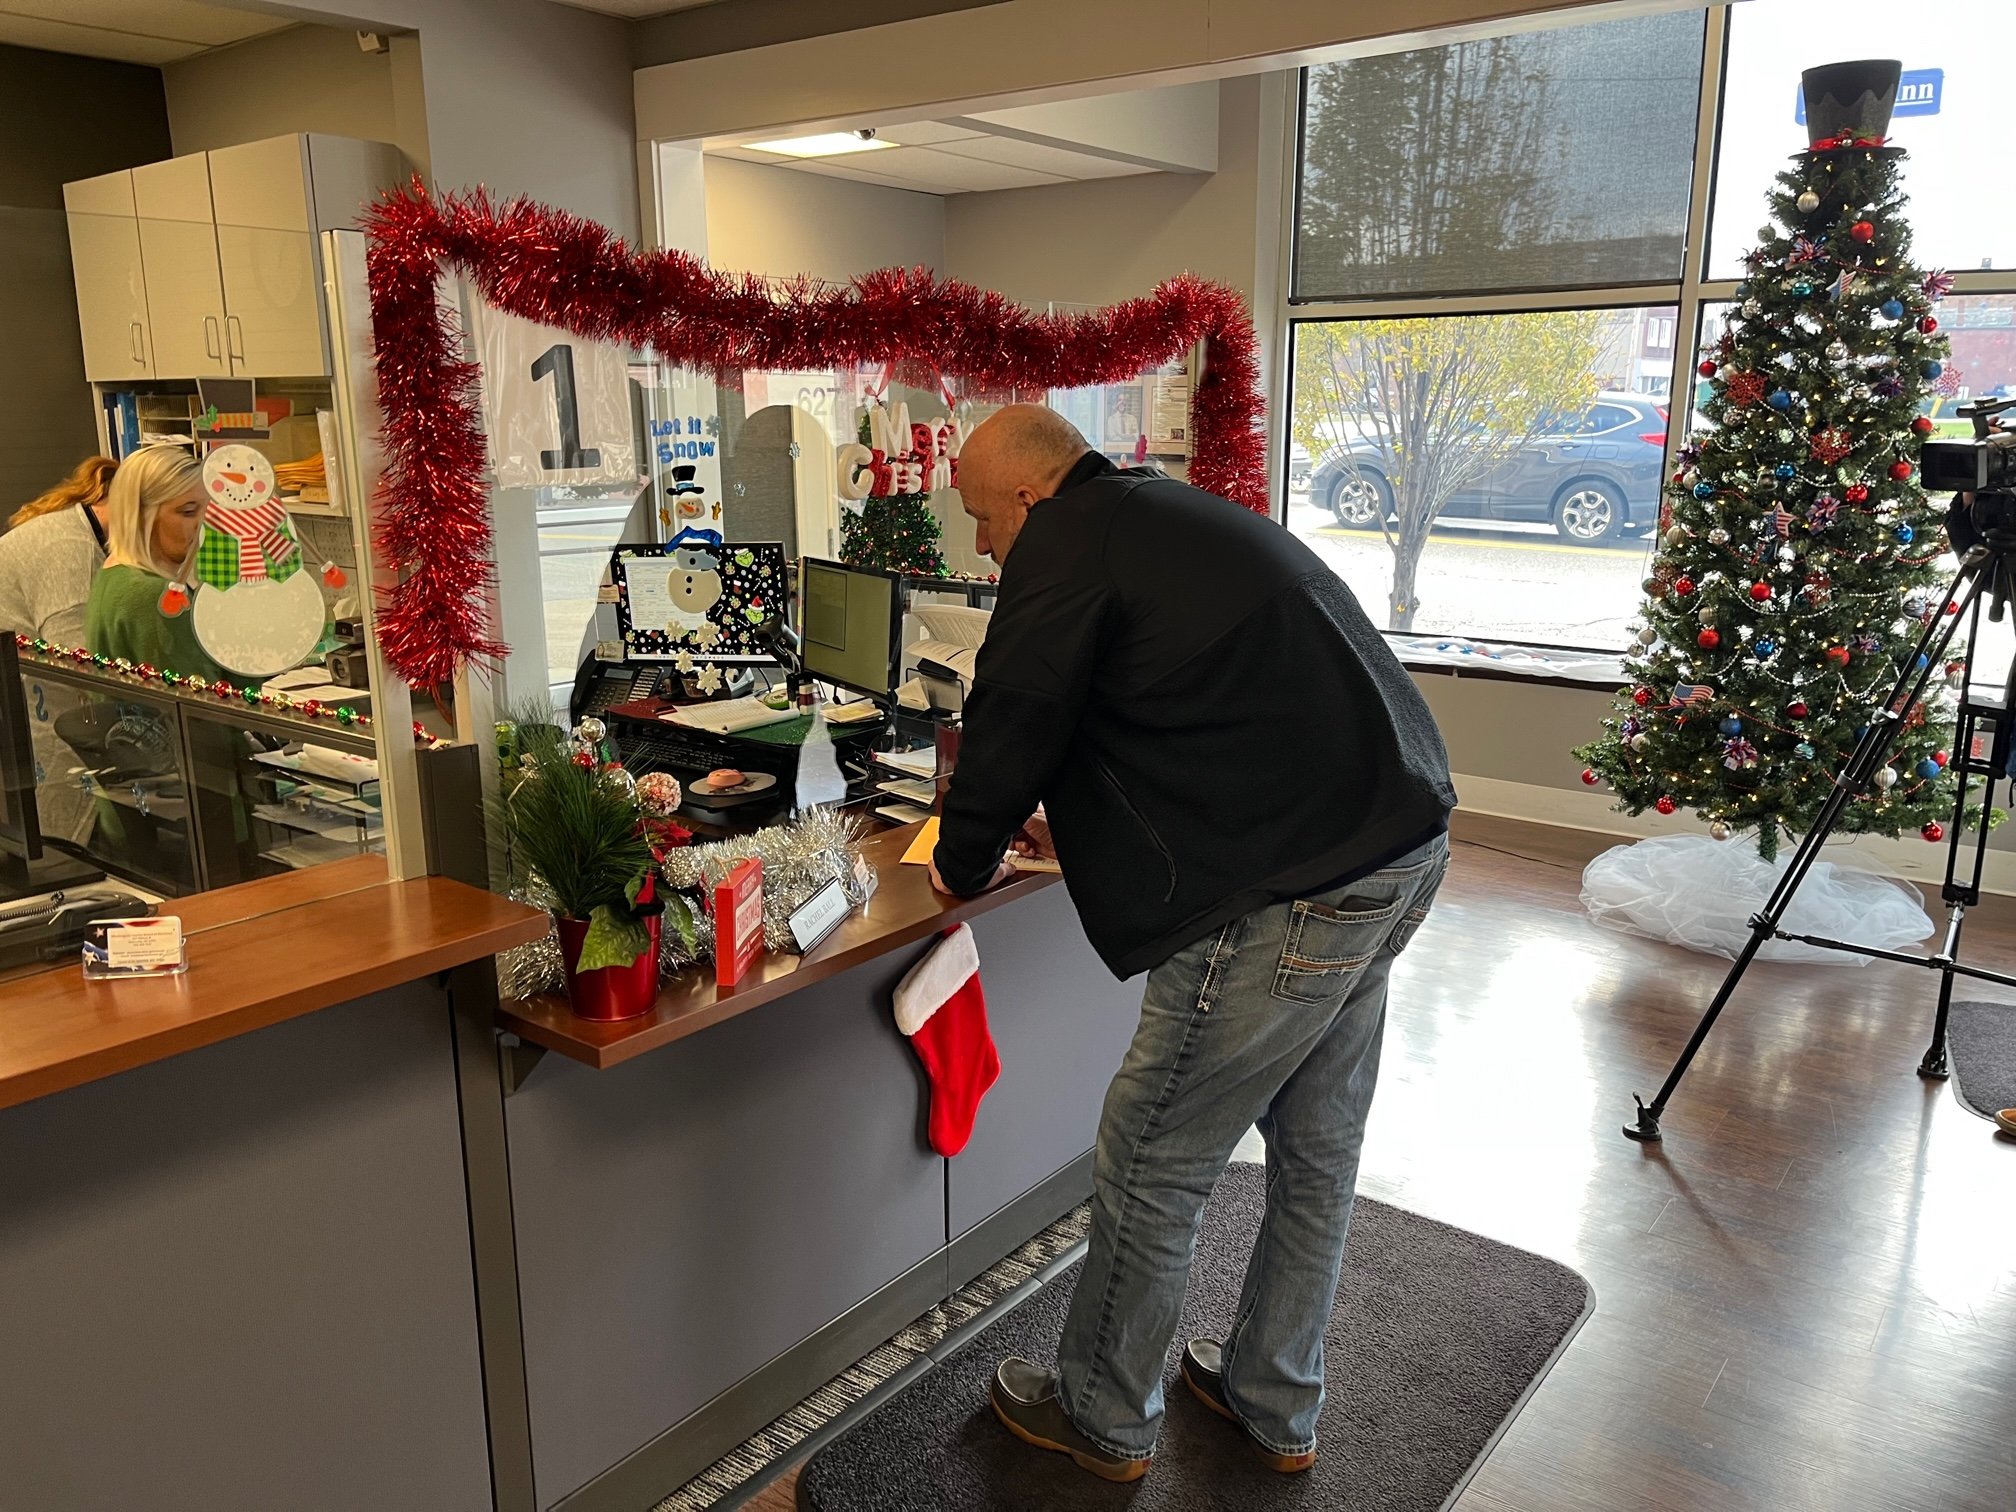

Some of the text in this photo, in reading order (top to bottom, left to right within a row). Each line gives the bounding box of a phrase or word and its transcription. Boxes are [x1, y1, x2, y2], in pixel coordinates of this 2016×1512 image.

[1895, 82, 1934, 101] nn
[531, 344, 601, 470] 1
[650, 418, 681, 437] Let
[837, 443, 958, 500] Christm
